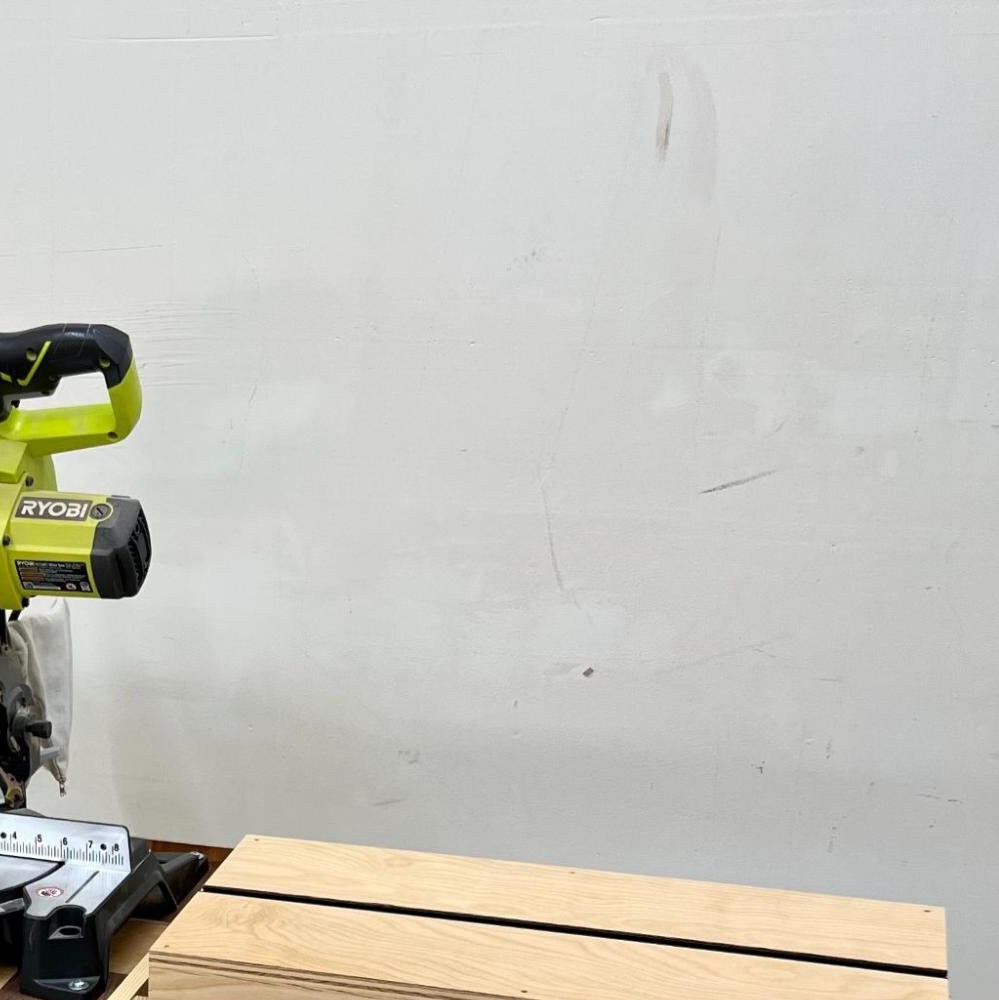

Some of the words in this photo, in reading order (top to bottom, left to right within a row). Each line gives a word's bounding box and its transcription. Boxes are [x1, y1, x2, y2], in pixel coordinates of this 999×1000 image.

[21, 500, 88, 518] RYOBI
[12, 831, 17, 839] 4
[37, 834, 42, 842] 5
[62, 837, 68, 845] 6
[88, 840, 93, 848] 7
[114, 843, 119, 851] 8
